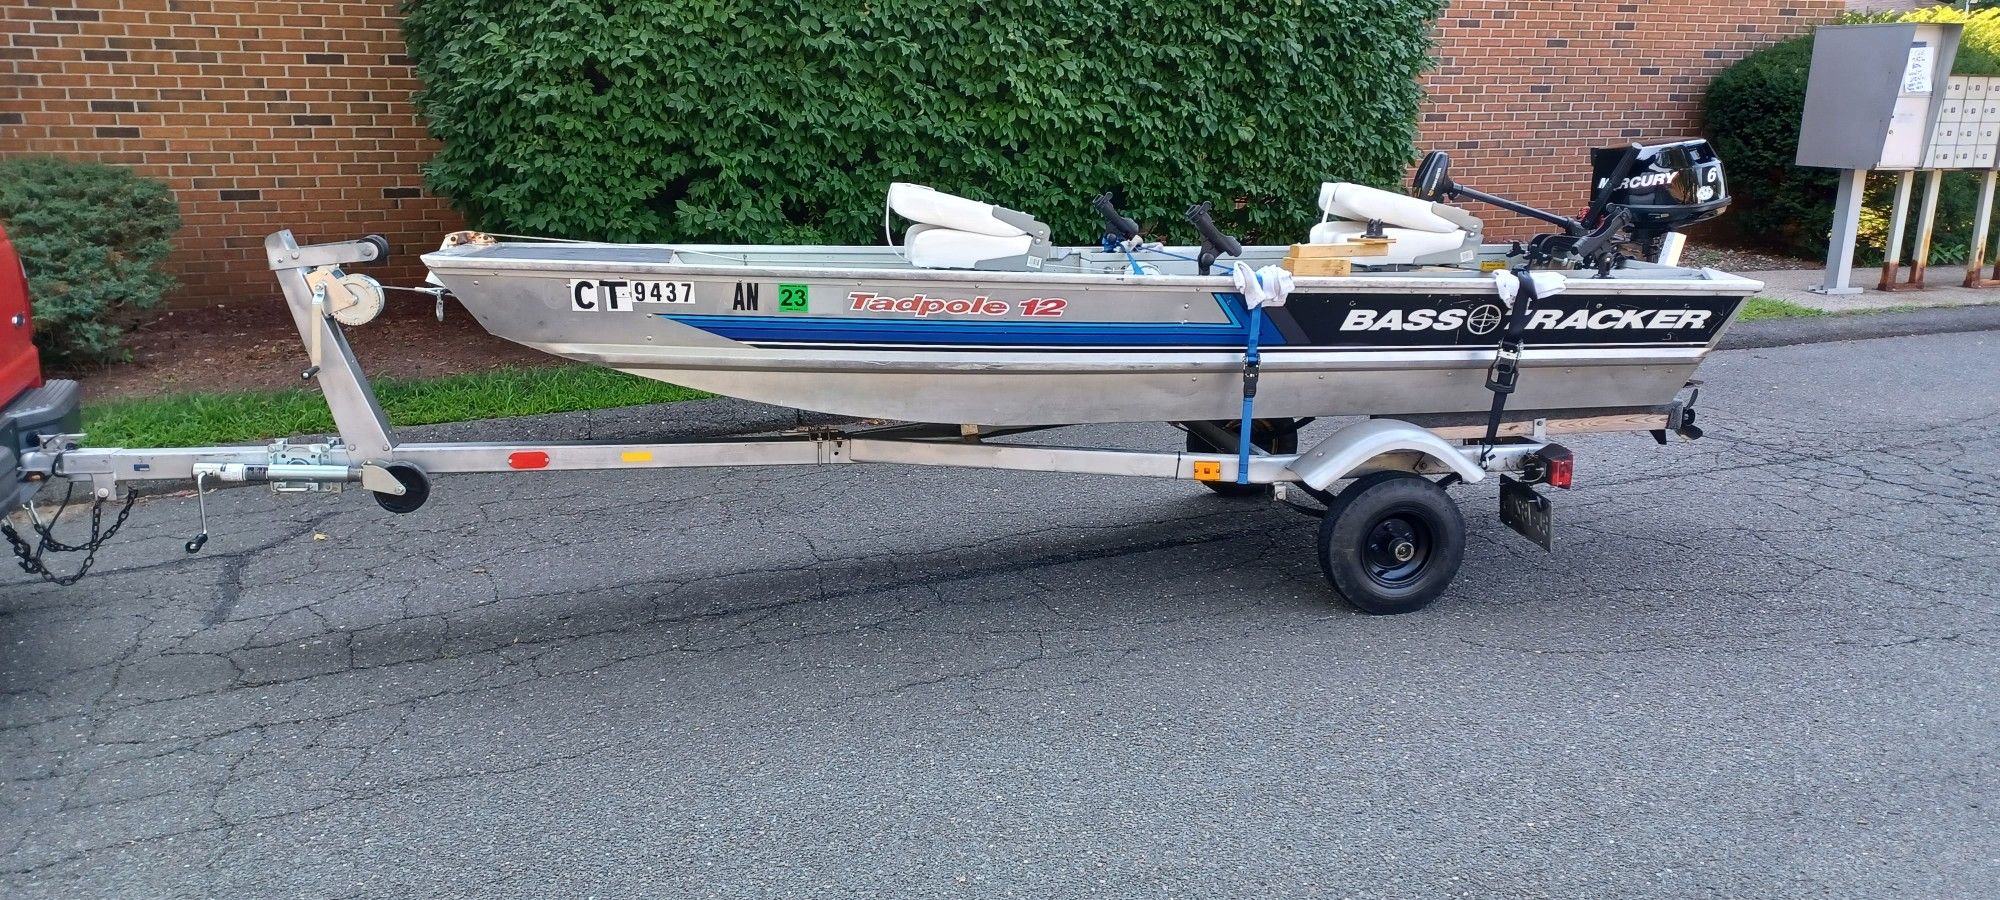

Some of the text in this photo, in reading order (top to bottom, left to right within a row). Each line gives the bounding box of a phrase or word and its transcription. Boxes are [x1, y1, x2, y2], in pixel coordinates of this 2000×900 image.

[1597, 171, 1679, 191] MRCURY
[1707, 167, 1717, 182] 6
[574, 280, 759, 310] CT 9437 AN
[781, 289, 806, 306] 23
[848, 292, 1067, 317] Tadpole 12
[1340, 308, 1467, 331] BASS
